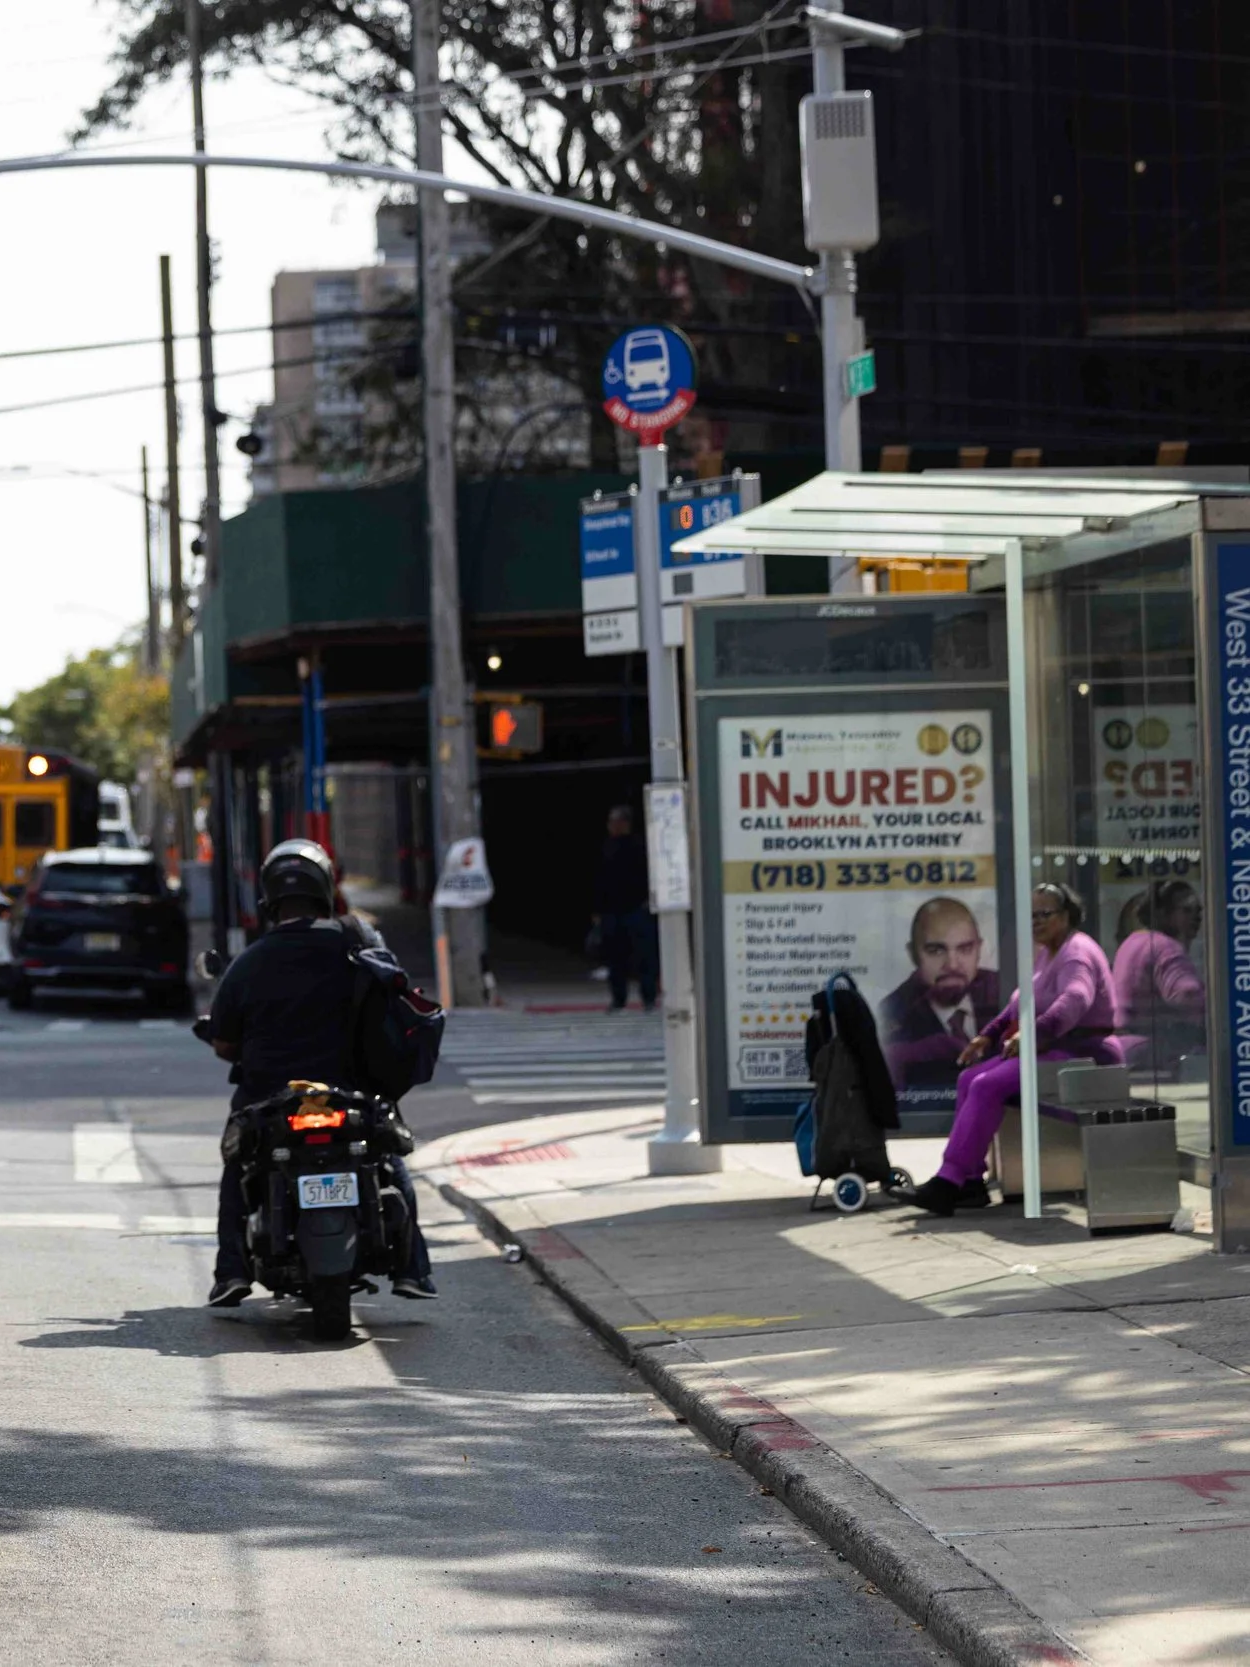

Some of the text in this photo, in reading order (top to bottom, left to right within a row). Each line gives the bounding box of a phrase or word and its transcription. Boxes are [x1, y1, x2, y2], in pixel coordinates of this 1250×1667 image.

[1225, 588, 1250, 668] West
[1227, 677, 1250, 714] 33
[739, 764, 985, 809] INJURED?
[1229, 724, 1250, 819] Street
[740, 815, 783, 830] CALL
[872, 812, 923, 828] YOUR
[926, 810, 985, 826] LOCAL
[762, 832, 963, 851] BROOKLYN ATTORNEY
[752, 860, 976, 890] (718) 333-0812
[1226, 860, 1250, 991] Neptune
